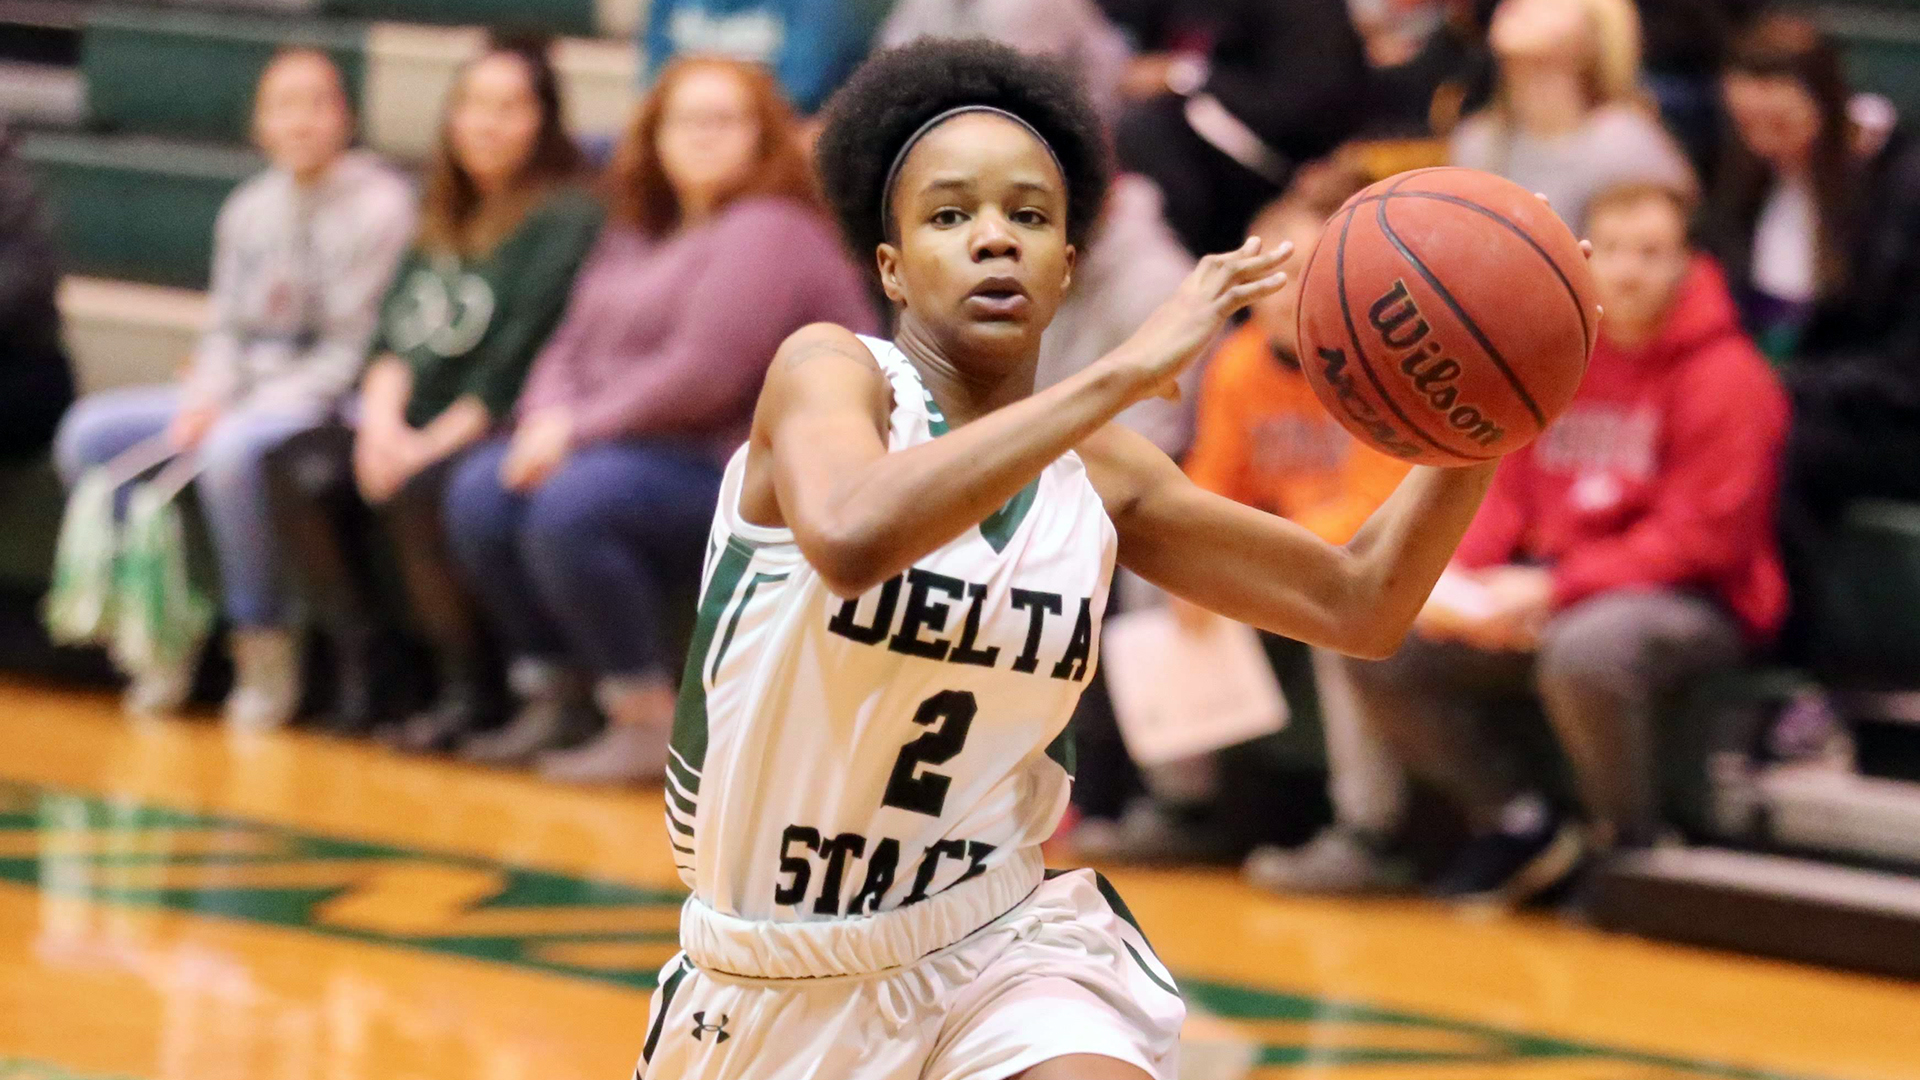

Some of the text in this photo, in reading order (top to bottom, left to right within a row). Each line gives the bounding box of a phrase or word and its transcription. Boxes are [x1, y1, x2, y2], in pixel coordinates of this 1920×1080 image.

[1368, 278, 1506, 447] Wilson
[827, 567, 1092, 682] DELTA
[880, 689, 978, 817] 2
